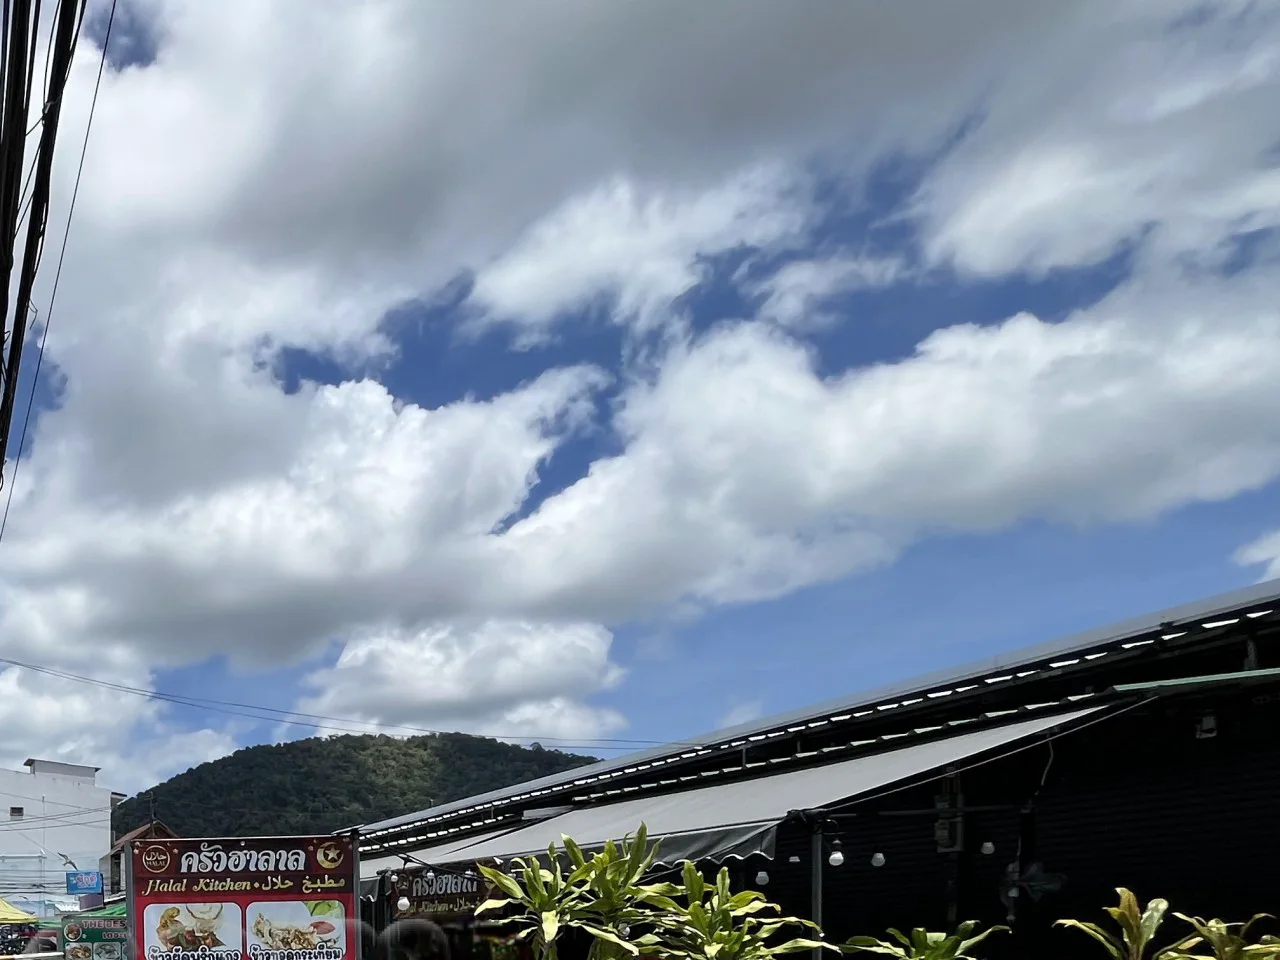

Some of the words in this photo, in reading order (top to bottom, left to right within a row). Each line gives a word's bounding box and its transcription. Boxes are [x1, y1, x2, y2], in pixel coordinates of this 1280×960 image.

[180, 842, 307, 873] ครัวฮาลาล
[142, 878, 187, 896] Halal
[192, 877, 251, 892] Kitchen
[105, 920, 128, 929] BES
